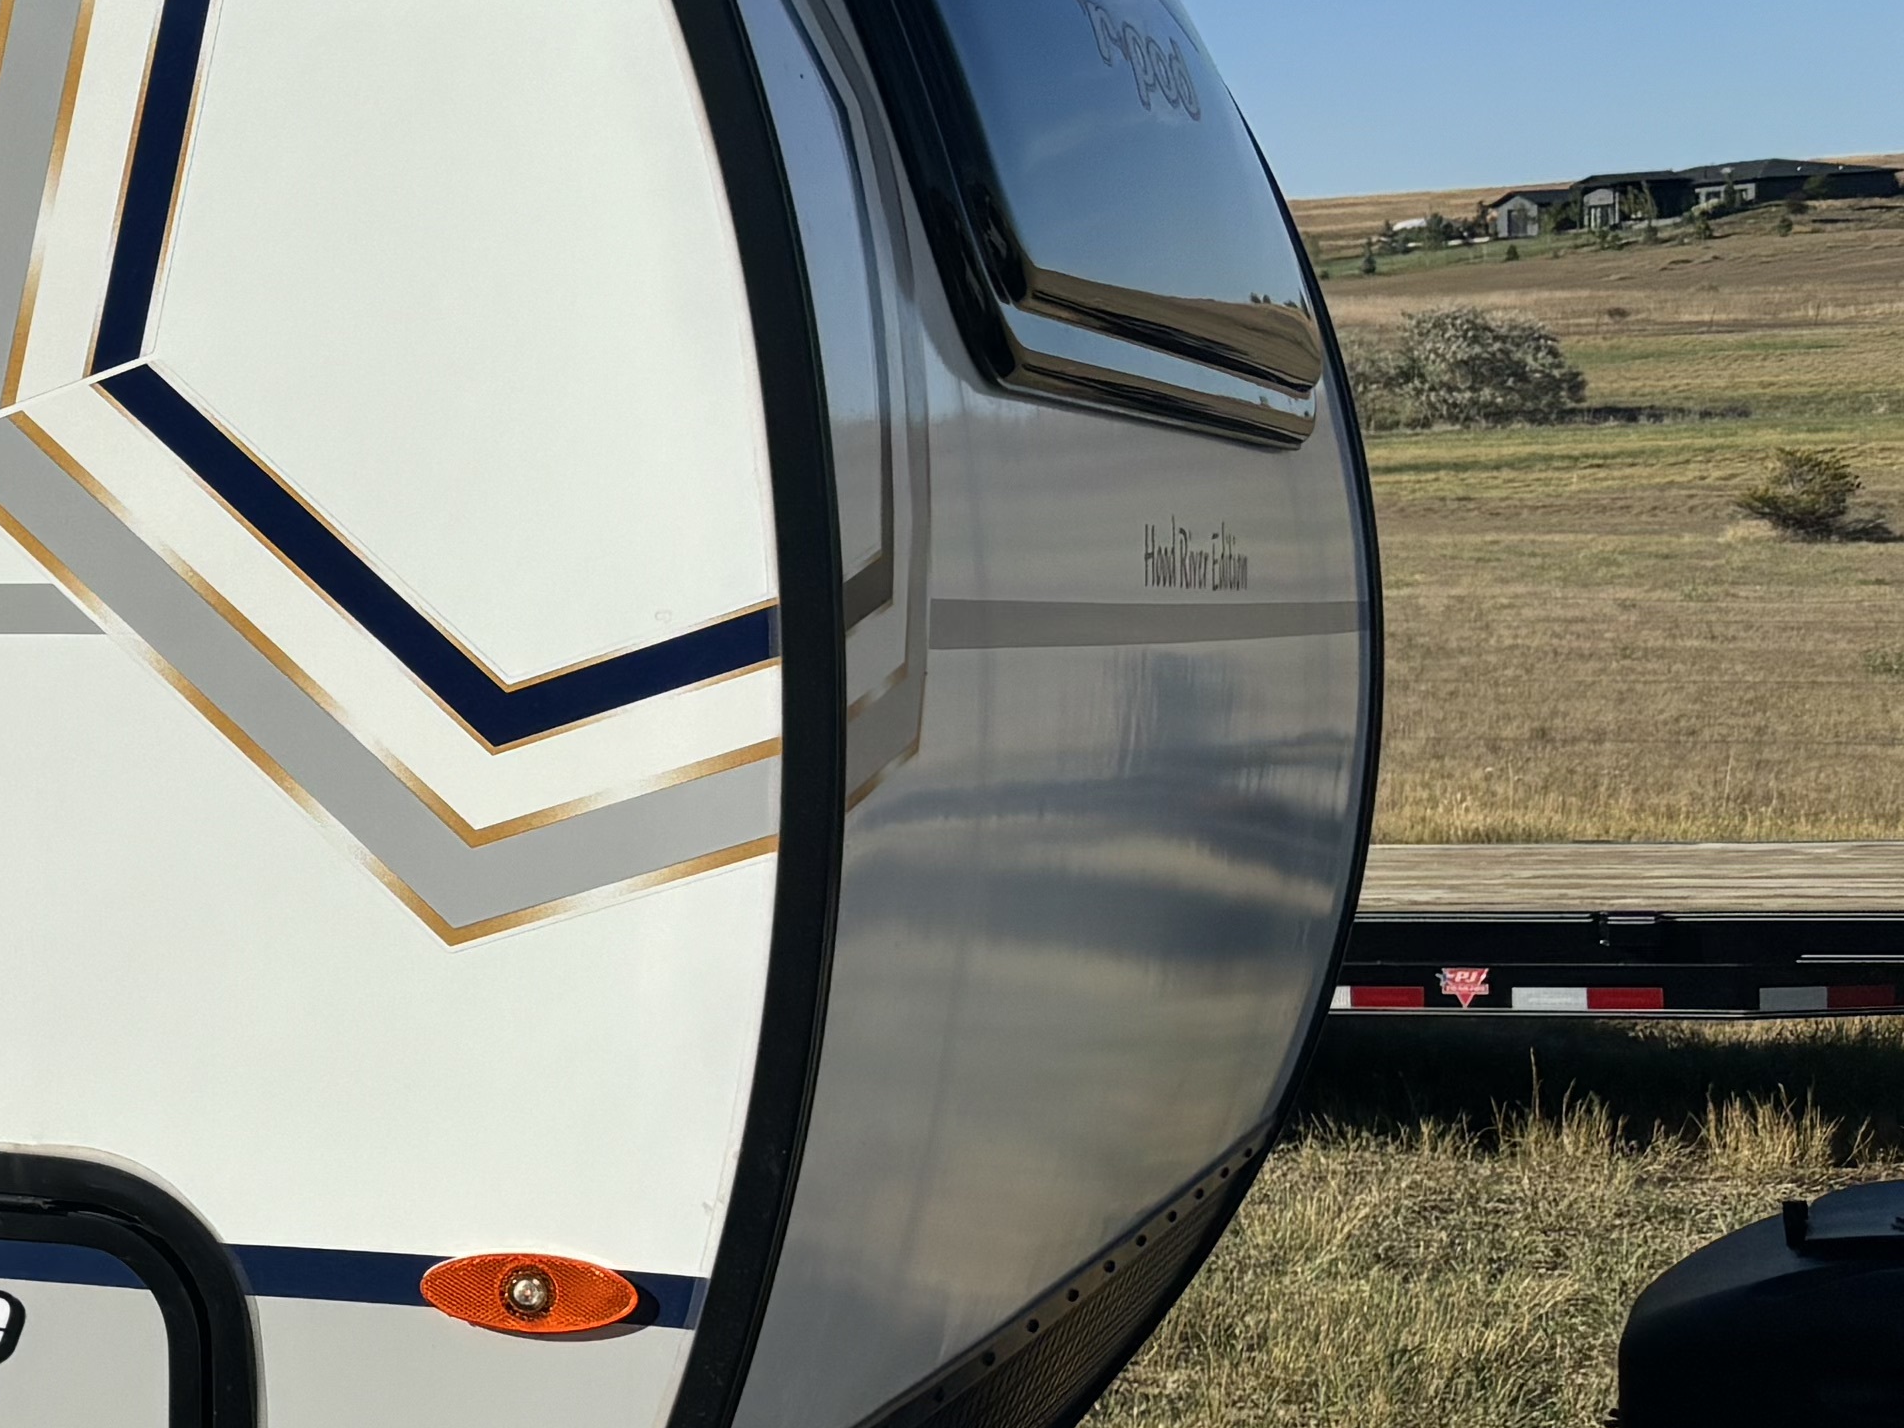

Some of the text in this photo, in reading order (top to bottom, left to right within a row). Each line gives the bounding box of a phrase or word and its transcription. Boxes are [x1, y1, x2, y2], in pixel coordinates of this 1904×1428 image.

[1144, 514, 1248, 592] Hood River Edition
